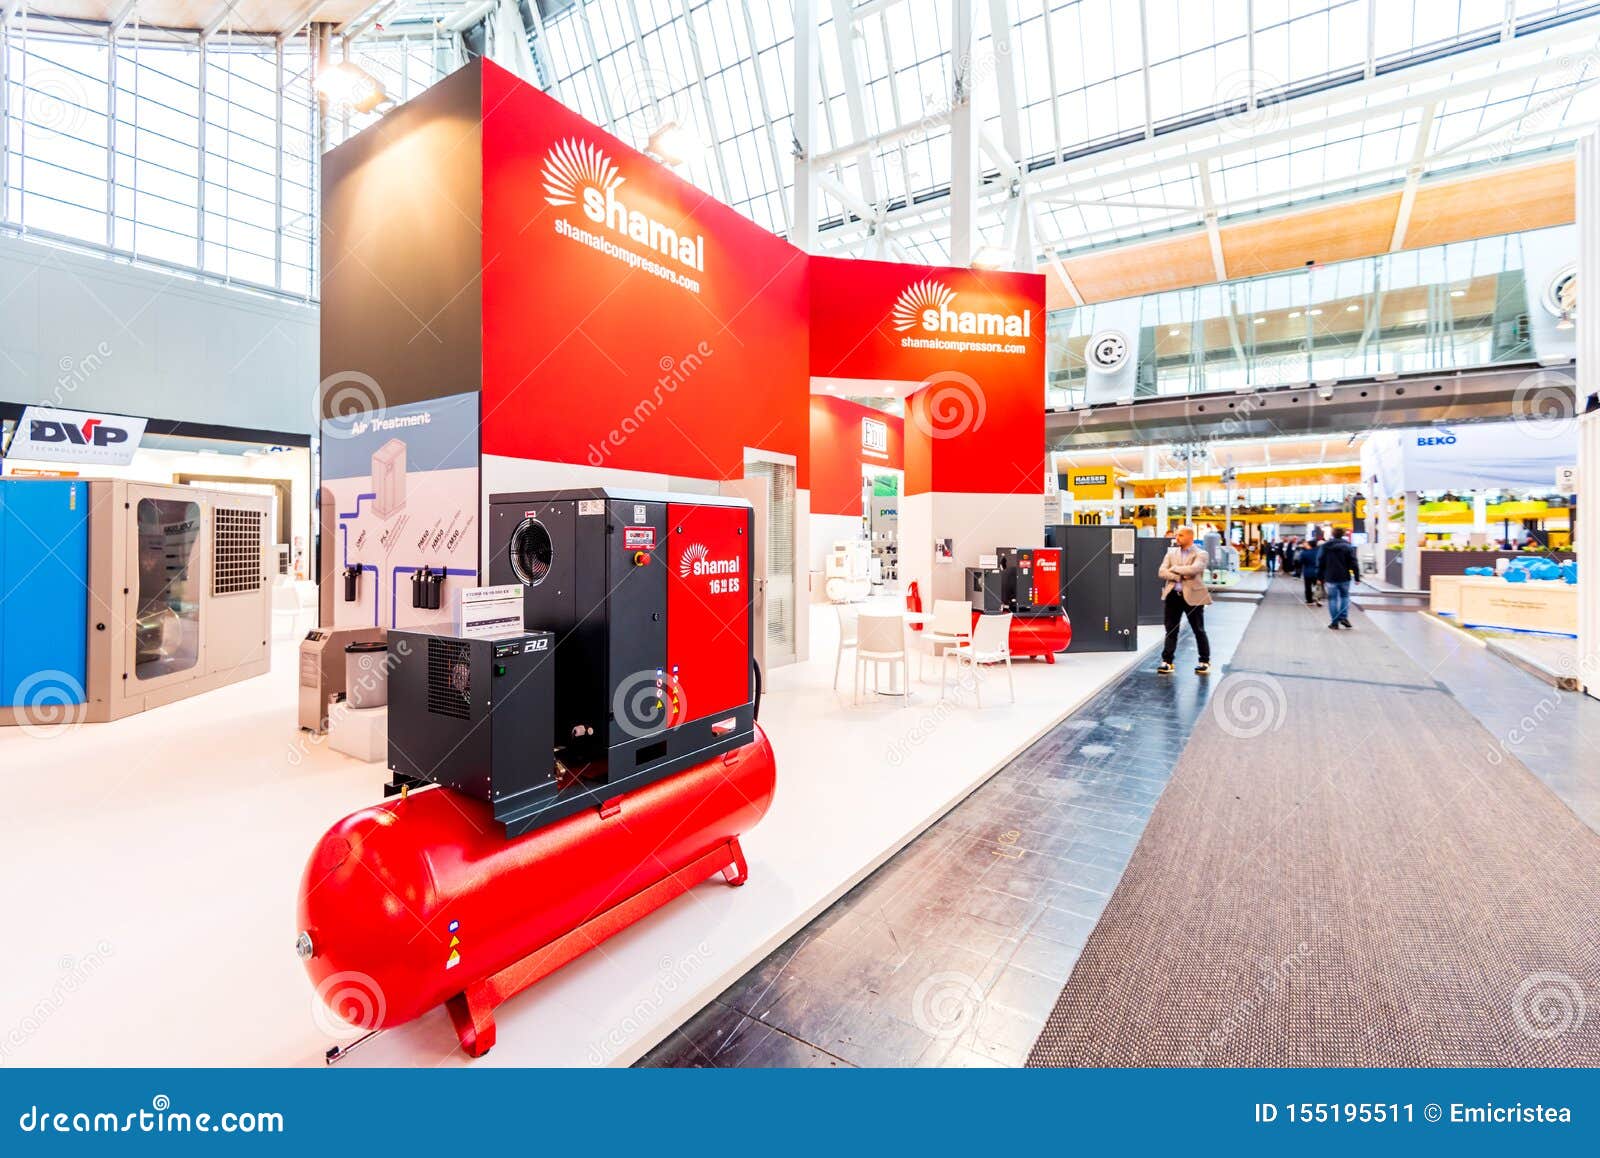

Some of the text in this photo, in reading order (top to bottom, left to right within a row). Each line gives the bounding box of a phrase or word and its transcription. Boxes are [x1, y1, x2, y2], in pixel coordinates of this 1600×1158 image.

[583, 186, 705, 272] shamal
[554, 216, 701, 293] shamalcompressors.com
[922, 303, 1031, 337] shamal
[901, 335, 1026, 355] shamalcompressors.com
[30, 418, 129, 447] DVP
[351, 412, 432, 436] Air Treatment
[1417, 436, 1457, 447] BEKO
[693, 555, 740, 576] shamal
[709, 579, 720, 594] 16
[728, 577, 740, 593] ES
